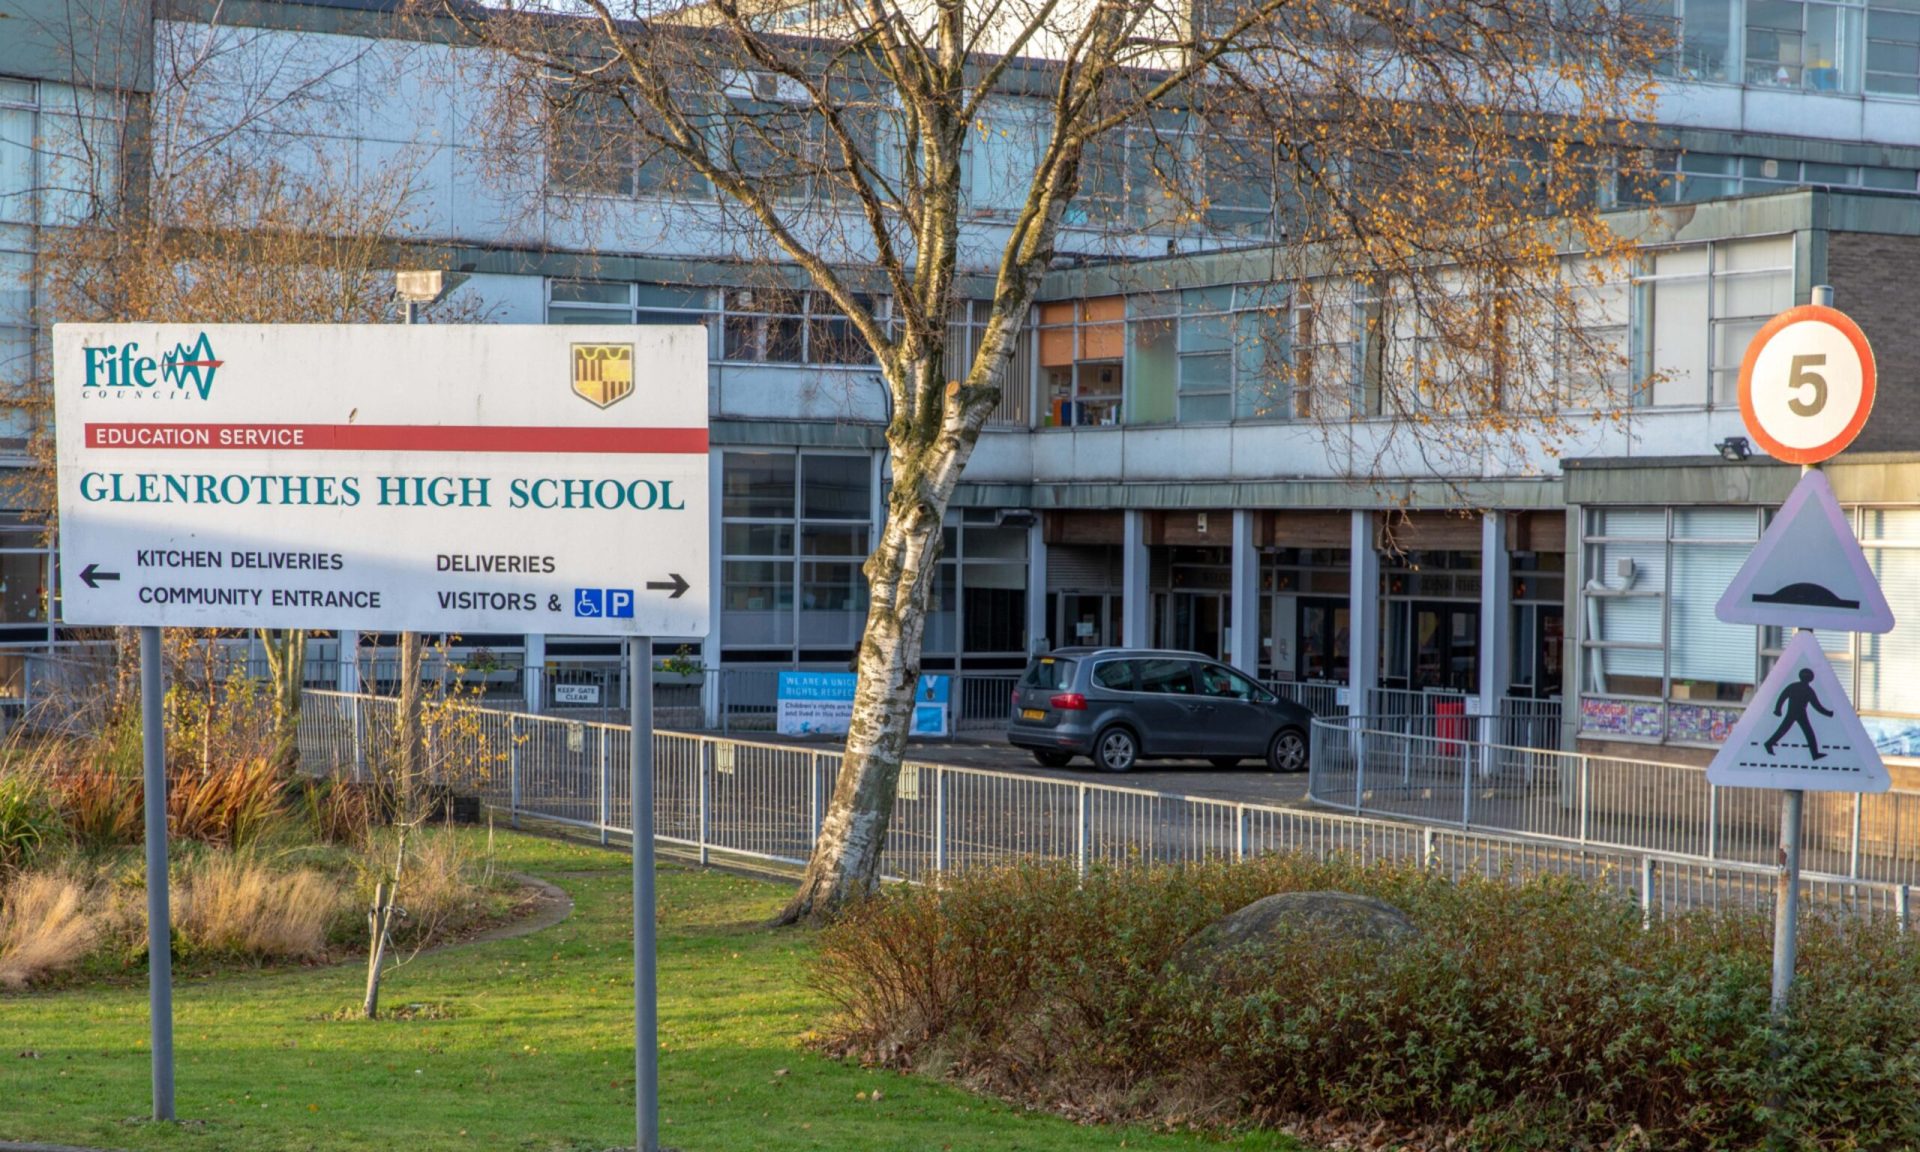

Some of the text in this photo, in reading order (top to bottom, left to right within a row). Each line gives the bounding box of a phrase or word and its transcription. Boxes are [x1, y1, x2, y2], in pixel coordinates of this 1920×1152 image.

[82, 342, 157, 388] Fife
[82, 389, 194, 400] COUNCIL
[1788, 353, 1828, 417] 5
[96, 428, 304, 446] EDUCATION SERVICE
[80, 472, 685, 510] GLENROTHES HIGH SCHOOL
[137, 549, 343, 571] KITCHEN DELIVERIES
[436, 554, 556, 574] DELIVERIES
[138, 586, 381, 609] COMMUNITY ENTRANCE
[437, 591, 537, 611] VISITORS
[547, 593, 562, 612] &
[578, 687, 595, 695] GATE
[785, 687, 818, 696] RIGHTS
[786, 678, 798, 686] WE
[803, 678, 818, 686] ARE
